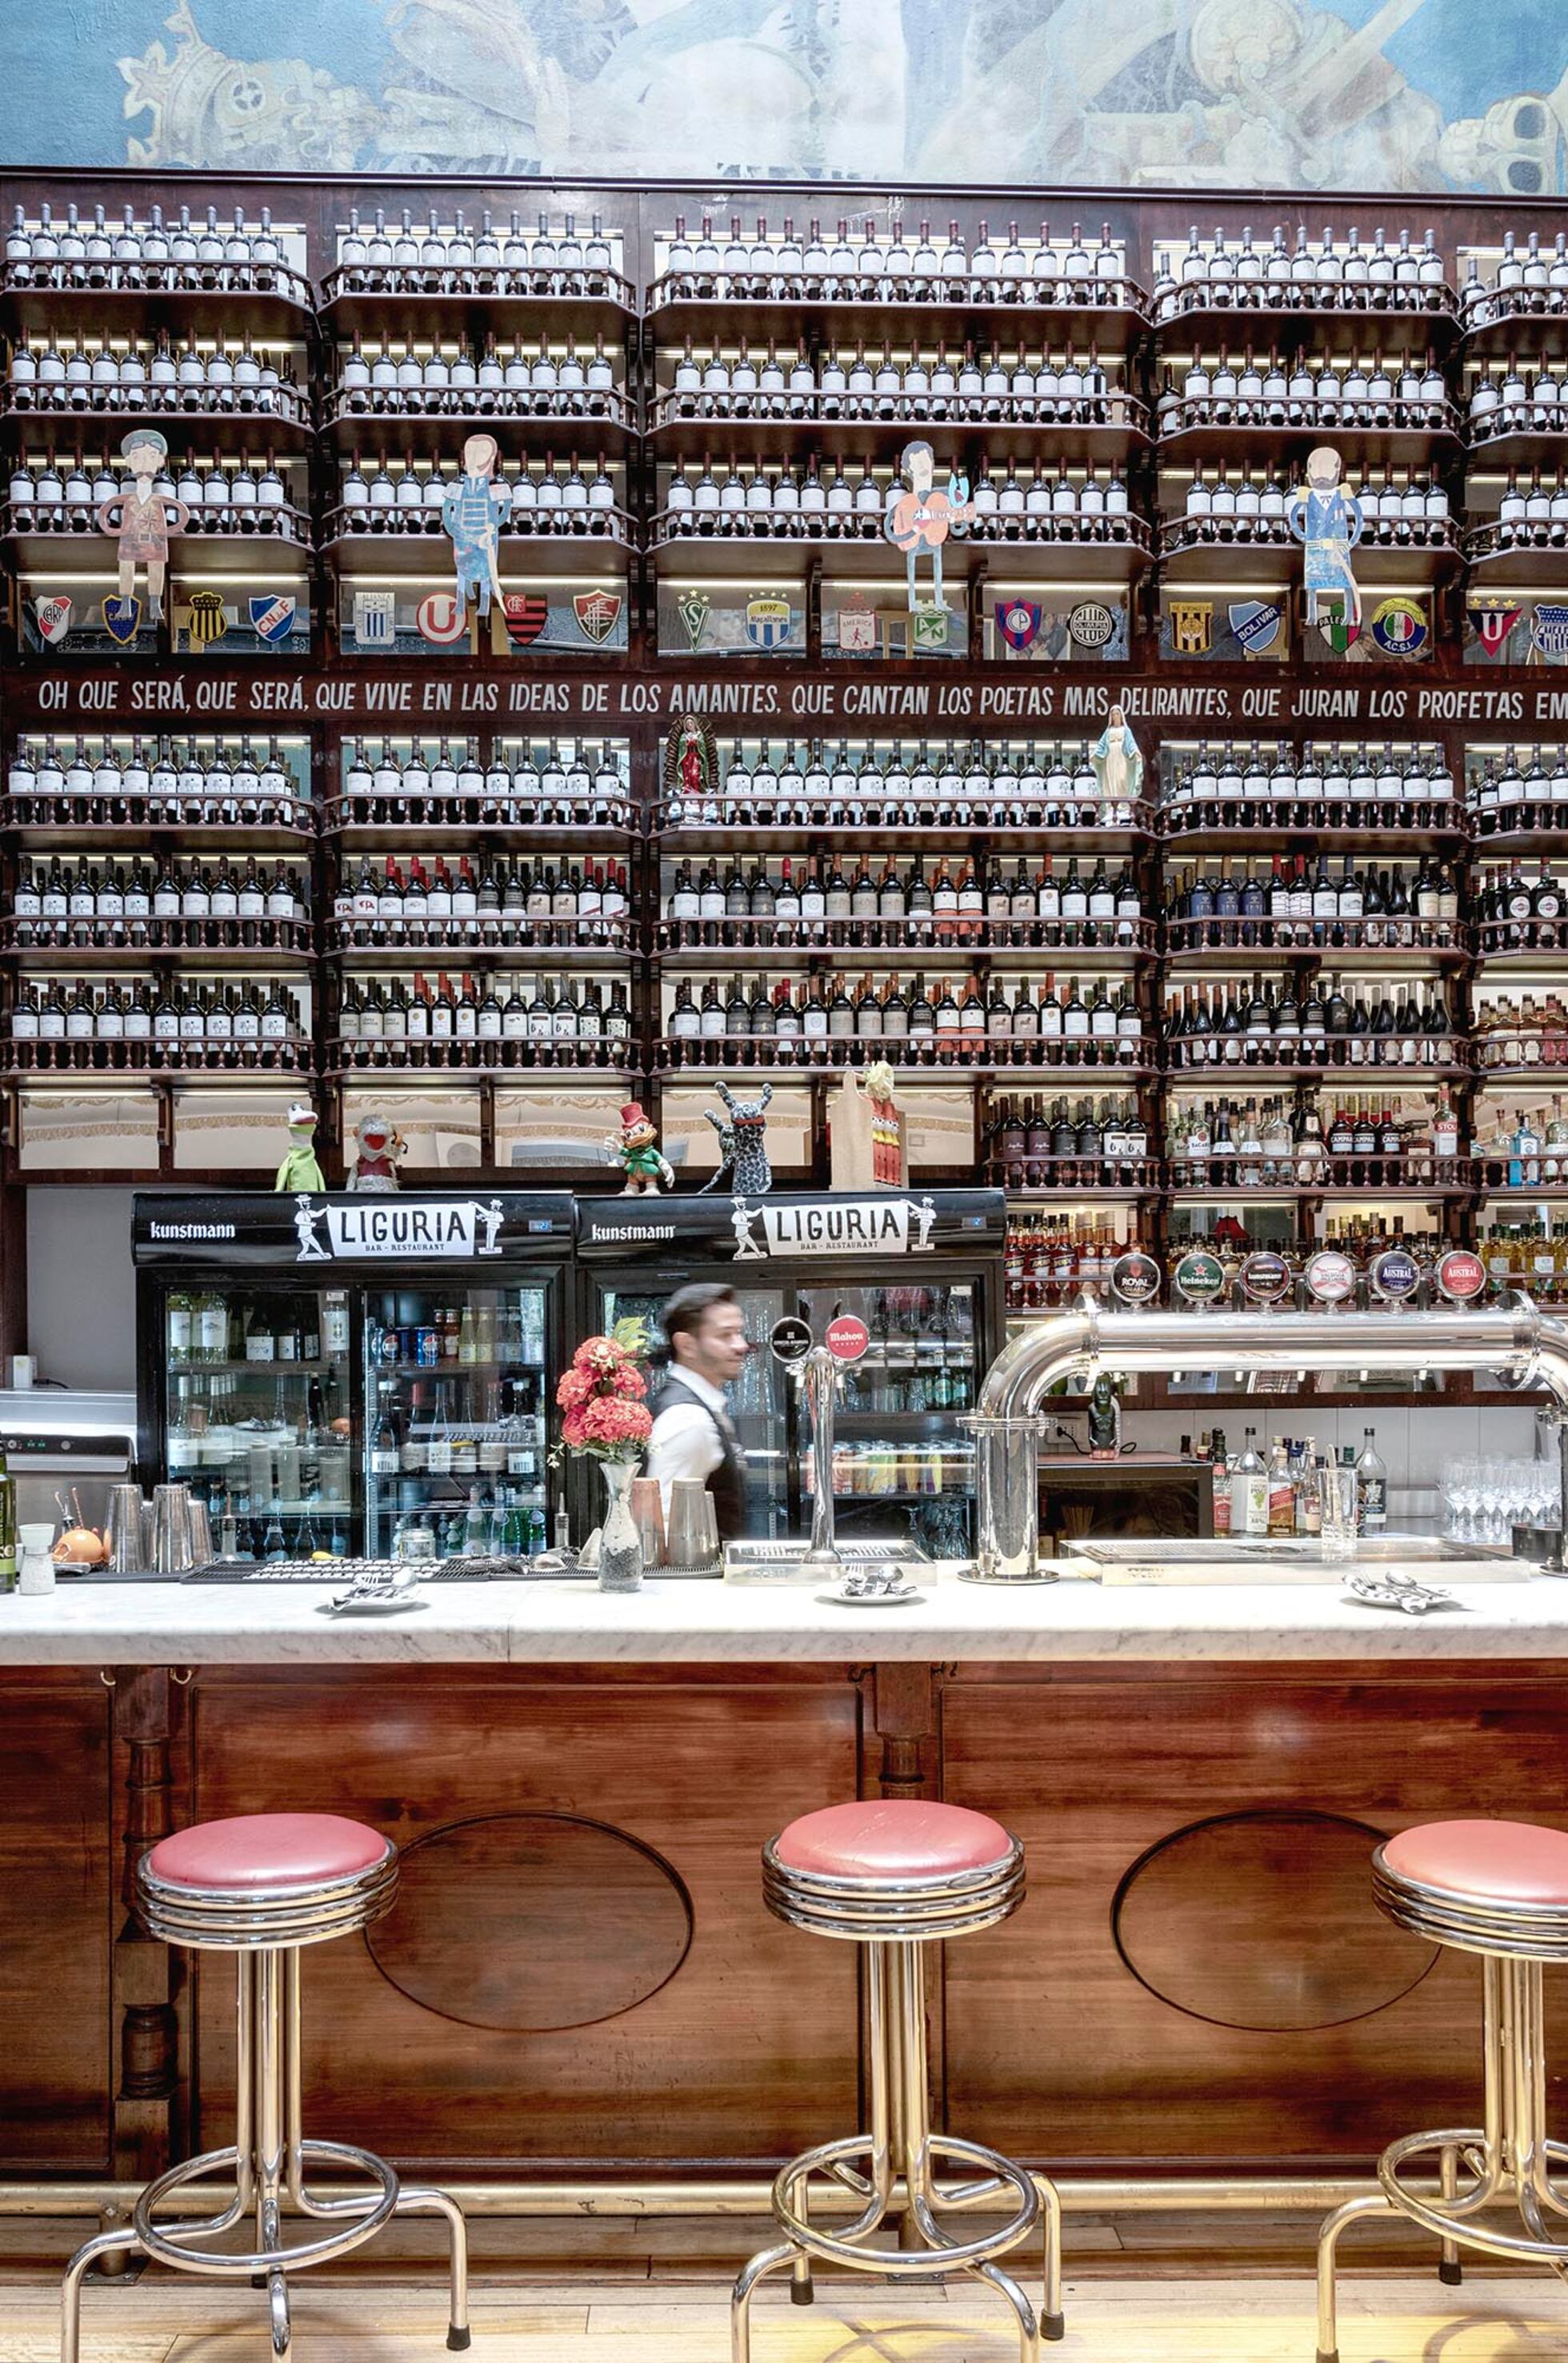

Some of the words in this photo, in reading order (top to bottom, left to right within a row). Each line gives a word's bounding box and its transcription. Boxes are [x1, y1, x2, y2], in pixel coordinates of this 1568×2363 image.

[427, 601, 457, 634] U
[1481, 613, 1505, 641] U
[39, 681, 68, 710] OH
[79, 681, 118, 710] QUE
[131, 674, 191, 714] SERÁ,
[196, 682, 238, 710] QUE
[250, 675, 309, 713] SERÁ,
[315, 682, 356, 710] QUE
[365, 682, 413, 711] VIVE
[422, 682, 453, 711] EN
[461, 683, 499, 711] LAS
[508, 683, 570, 712] IDEAS
[582, 683, 610, 713] DE
[620, 684, 662, 713] LOS
[669, 684, 782, 714] AMANTES,
[791, 685, 834, 714] QUE
[842, 686, 930, 715] CANTAN
[938, 686, 974, 716] LOS
[980, 686, 1054, 716] POETAS
[1062, 686, 1109, 716] MAS
[1120, 687, 1232, 719] DELIRANTES,
[1242, 688, 1282, 718] QUE
[1290, 690, 1360, 718] JURAN
[1369, 690, 1408, 718] LOS
[1418, 690, 1523, 720] PROFETAS
[150, 1221, 236, 1239] kunstmann
[341, 1210, 467, 1243] LIGURIA
[591, 1223, 676, 1241] kunstmann
[776, 1209, 902, 1242] LIGURIA
[391, 1243, 445, 1252] RESTAURANT
[826, 1241, 878, 1249] RESTAURANT
[1382, 1266, 1414, 1279] AUSTRAL
[1447, 1266, 1479, 1278] AUSTRAL
[1122, 1277, 1150, 1287] ROYAL
[1181, 1277, 1220, 1285] Heineken
[830, 1331, 864, 1341] Mahou
